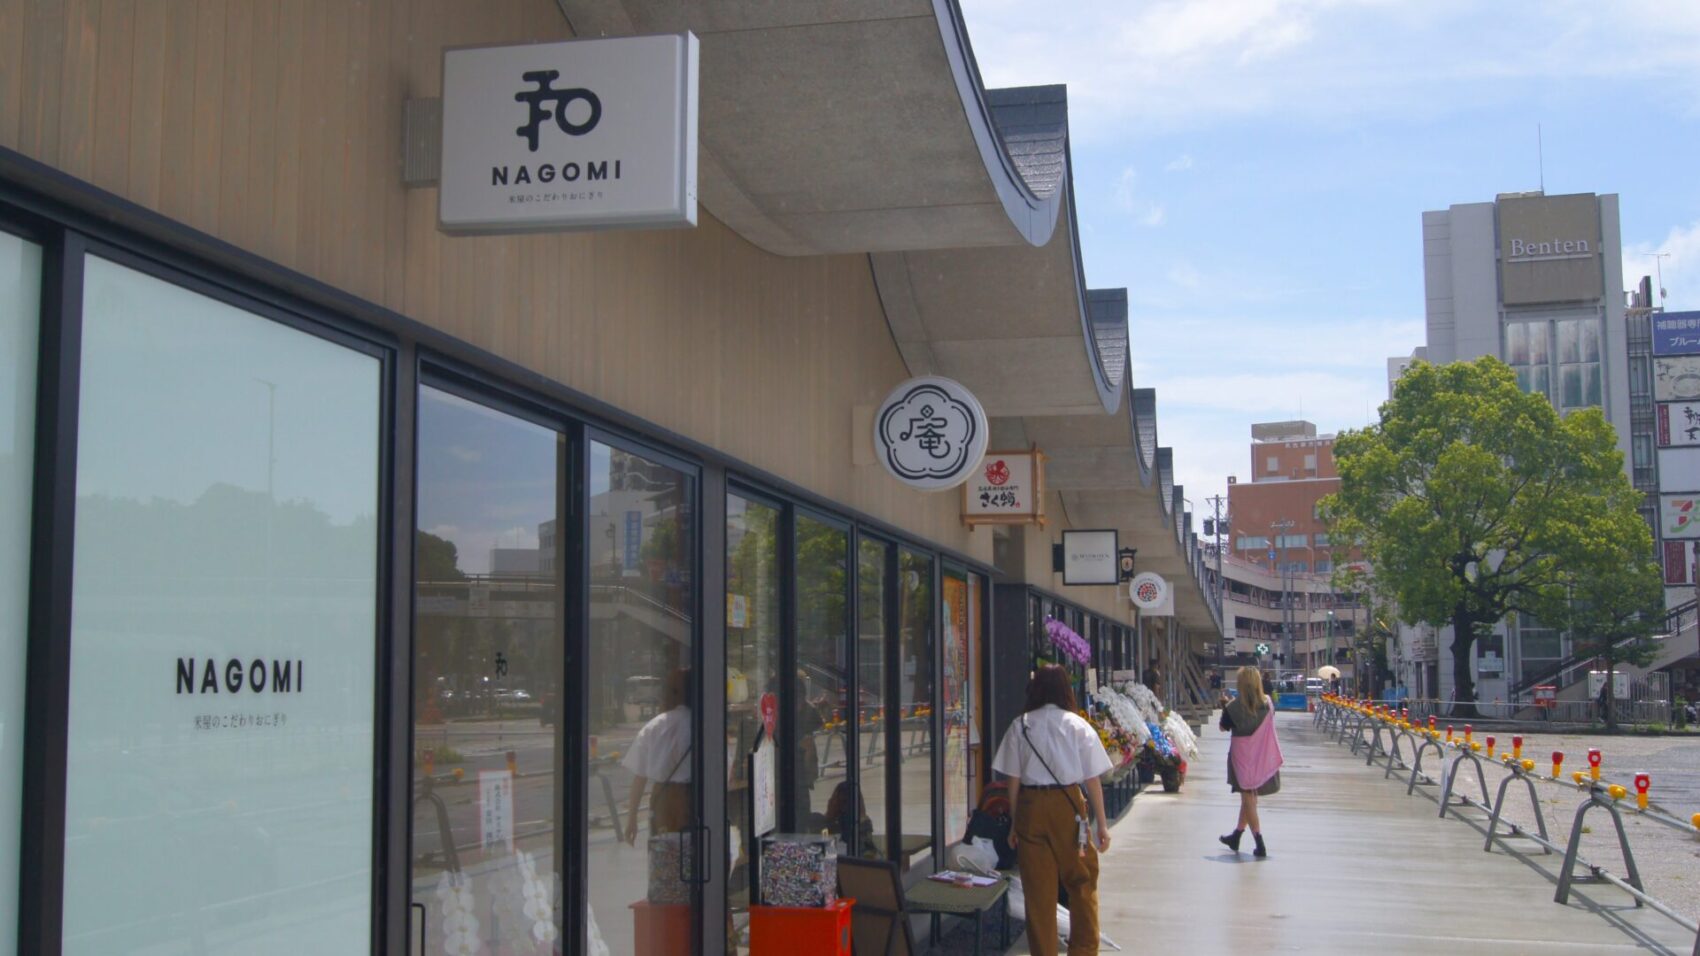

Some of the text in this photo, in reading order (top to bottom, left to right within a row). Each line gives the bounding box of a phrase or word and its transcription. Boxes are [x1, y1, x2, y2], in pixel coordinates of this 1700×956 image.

[491, 160, 621, 185] NAGOMI
[508, 191, 603, 203] 米屋のこだわりおにぎり
[1510, 238, 1589, 257] Benten
[176, 658, 303, 694] NAGOMI
[194, 712, 287, 730] 米屋のこだわりおにぎり
